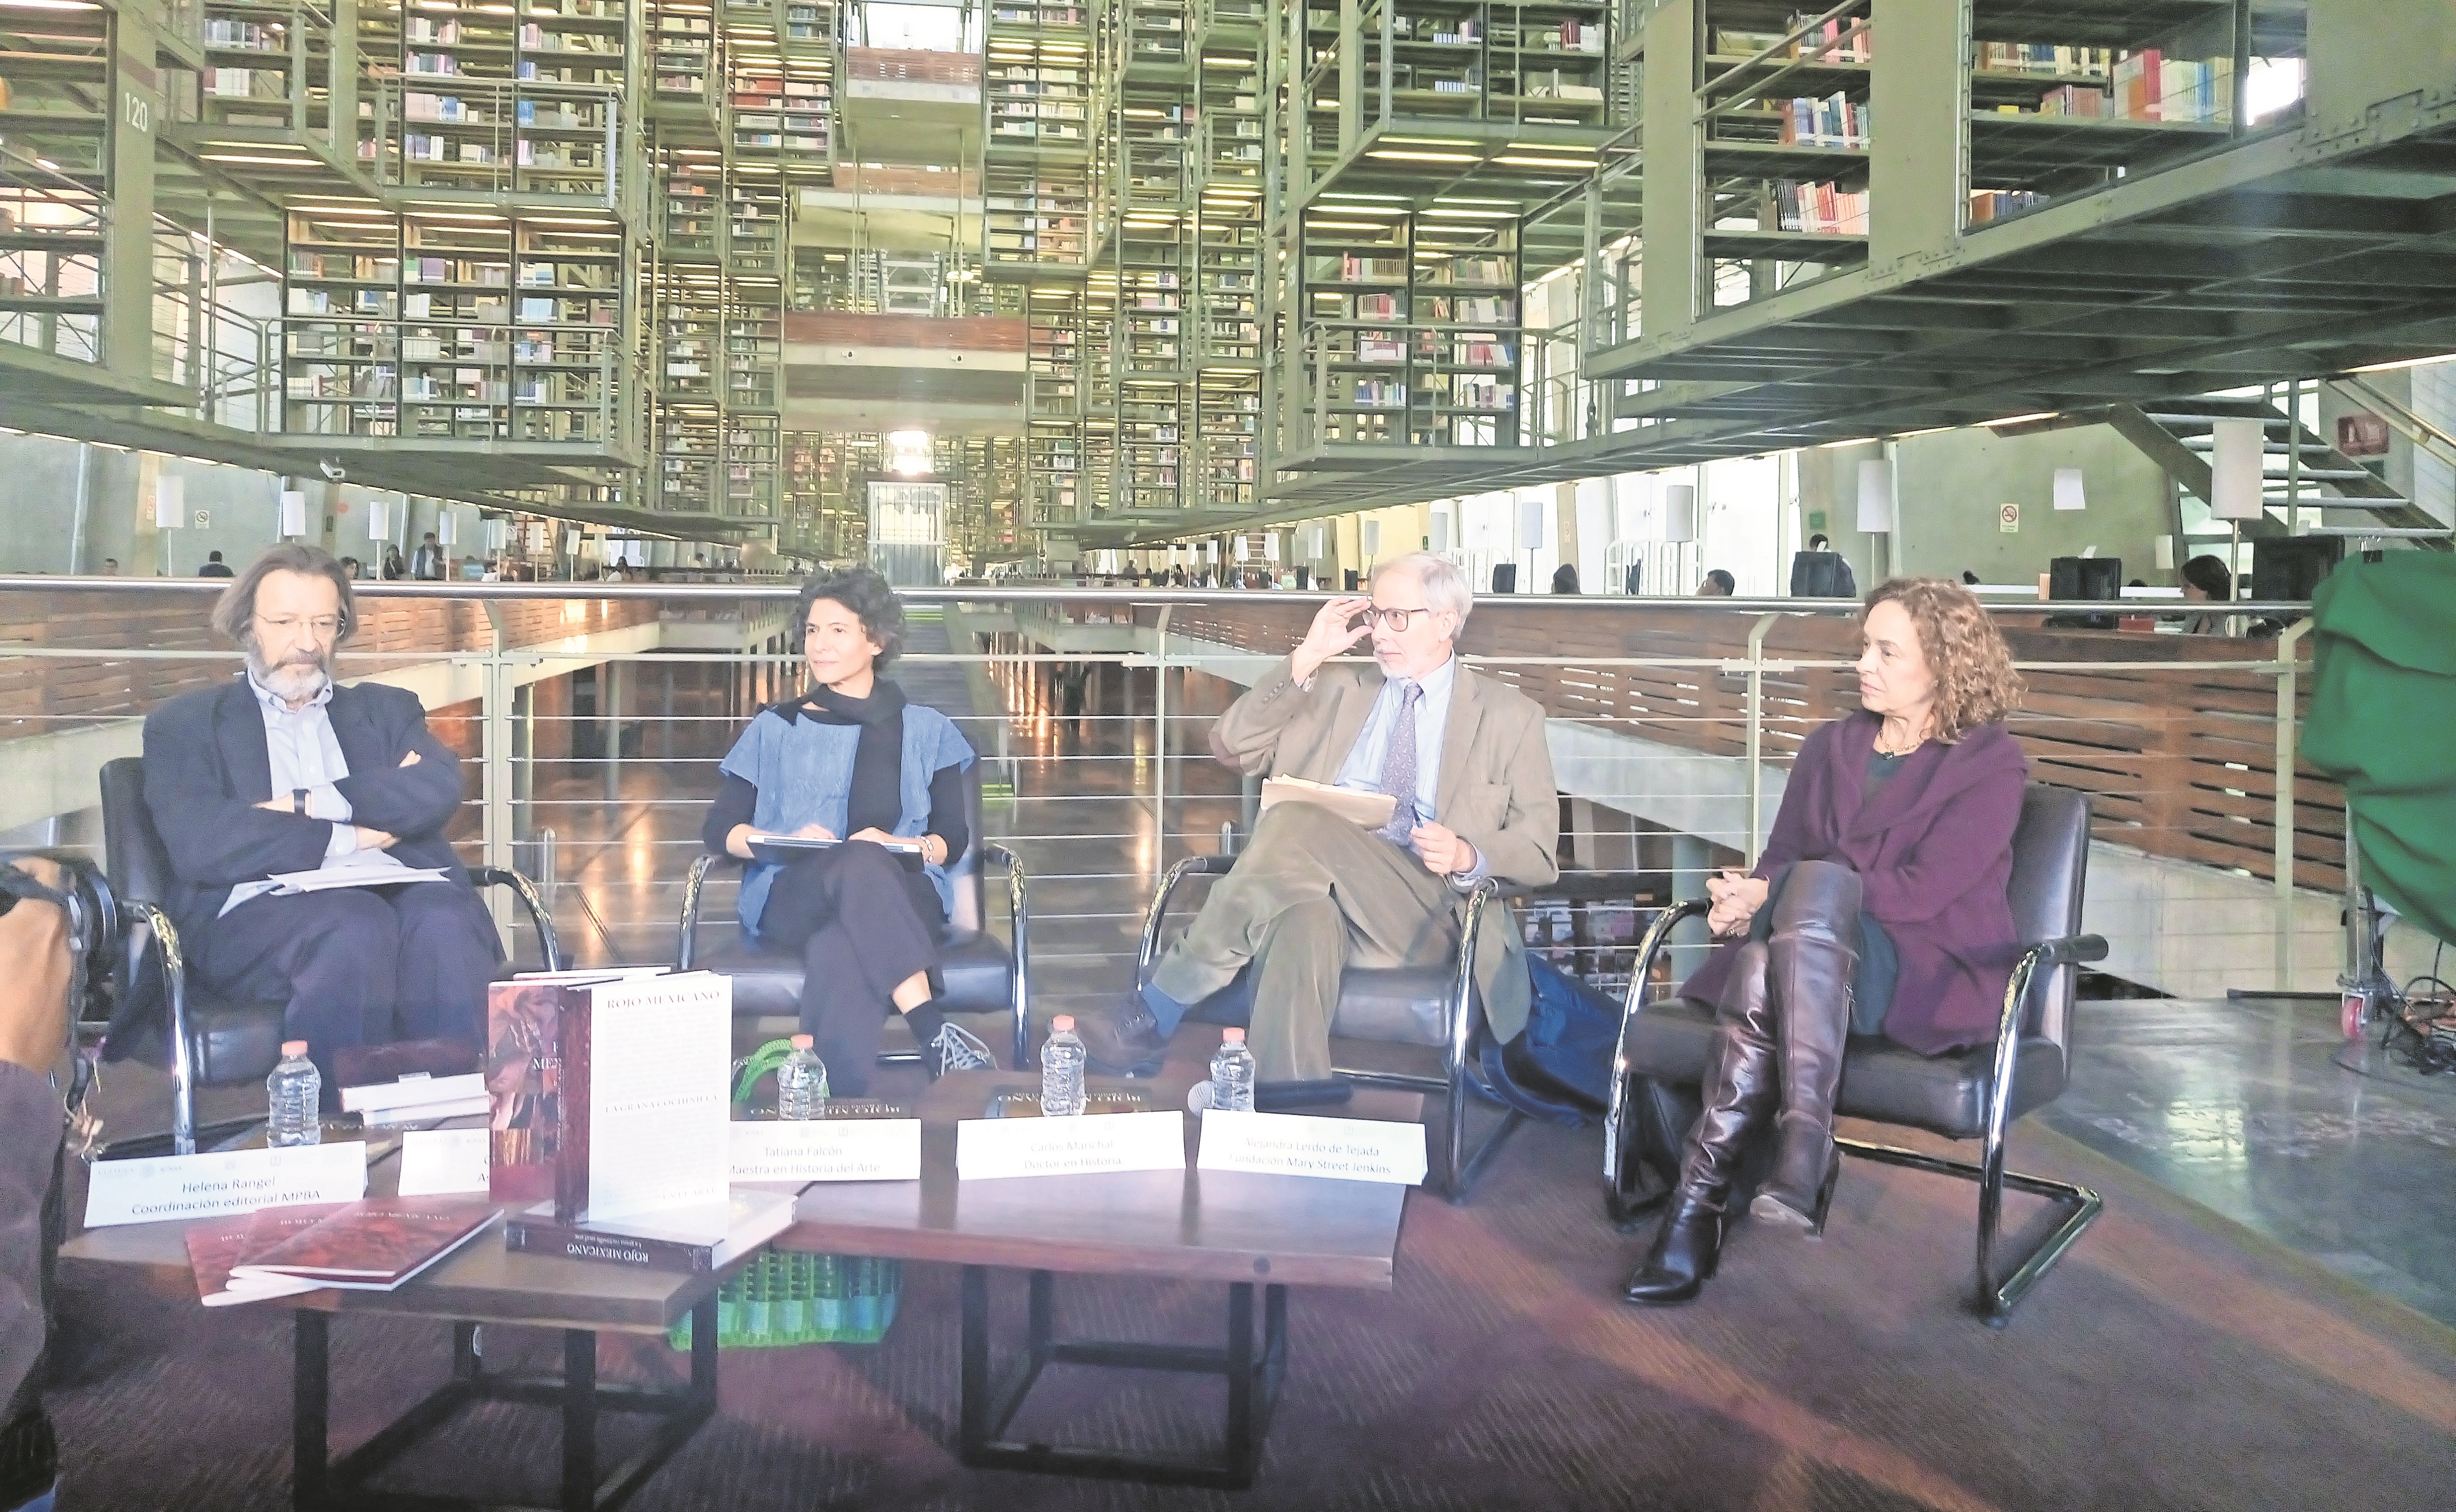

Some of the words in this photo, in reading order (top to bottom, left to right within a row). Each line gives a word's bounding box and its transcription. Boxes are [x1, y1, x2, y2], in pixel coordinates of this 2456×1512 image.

[125, 92, 147, 132] 120
[607, 997, 641, 1010] ROJO
[646, 989, 719, 1006] MEXICANO
[620, 1101, 655, 1111] GRANA
[764, 1146, 803, 1157] Tatiana
[807, 1145, 842, 1157] Falcón
[1031, 1141, 1063, 1152] Carlos
[1068, 1140, 1113, 1150] Marichal
[1244, 1138, 1292, 1150] Alejandra
[1296, 1141, 1326, 1152] Lerdo
[1329, 1144, 1342, 1153] de
[1346, 1145, 1379, 1156] Tejada
[774, 1165, 786, 1174] en
[791, 1163, 833, 1174] Historia
[837, 1163, 853, 1173] del
[857, 1163, 880, 1173] Arte
[1025, 1160, 1059, 1169] Doctor
[1081, 1157, 1121, 1166] Historia
[1229, 1153, 1283, 1166] Fundación
[1287, 1157, 1314, 1169] Mary
[1317, 1159, 1348, 1171] Street
[1352, 1163, 1390, 1174] Jenkins
[183, 1181, 227, 1193] Helena
[233, 1175, 275, 1190] Rangel
[132, 1199, 219, 1215] Coordinación
[224, 1193, 277, 1208] editorial
[282, 1190, 320, 1202] MPBA
[567, 1243, 621, 1260] MEXICANO
[623, 1249, 648, 1263] ROJO
